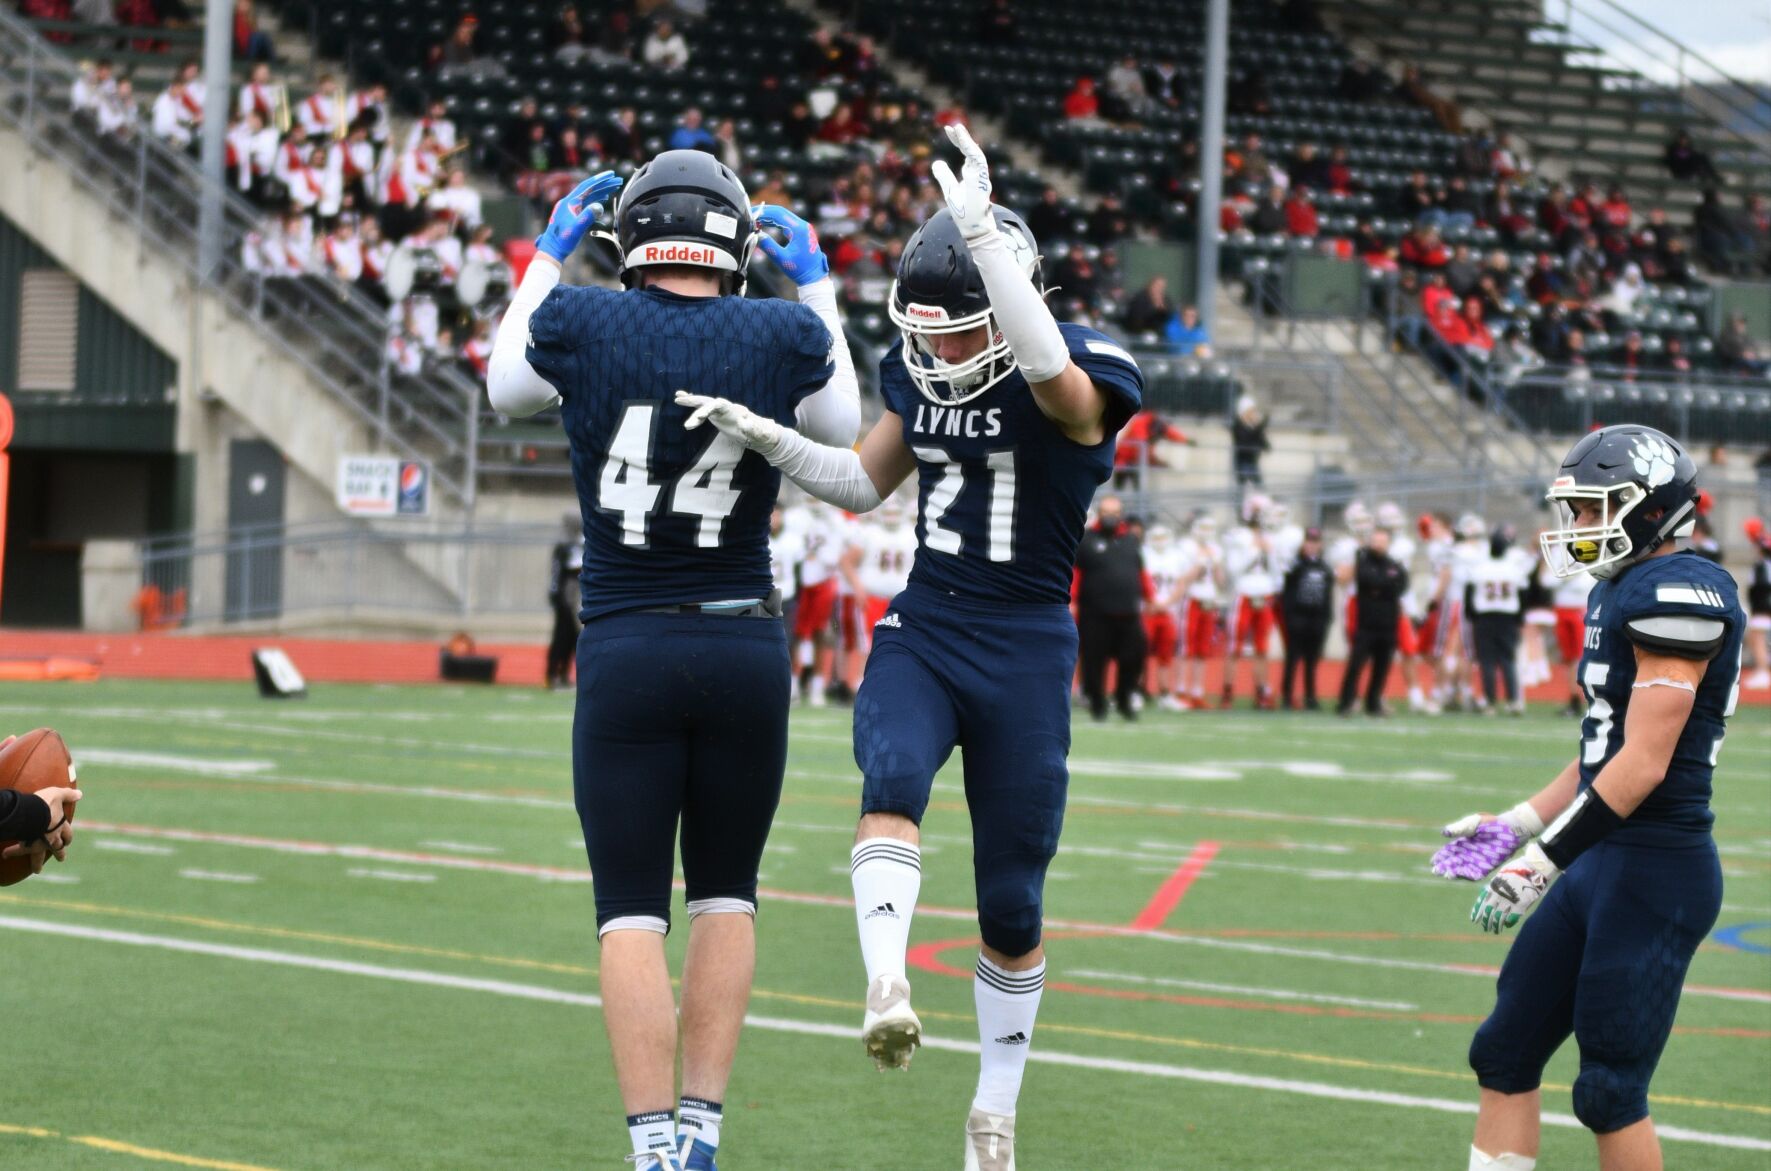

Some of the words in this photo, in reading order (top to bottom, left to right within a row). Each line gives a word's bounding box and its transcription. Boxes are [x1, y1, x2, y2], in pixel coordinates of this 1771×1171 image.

[645, 246, 715, 264] Riddell
[909, 307, 941, 318] Riddell
[913, 404, 1002, 438] LYNCS
[599, 406, 743, 548] 44
[912, 446, 1016, 562] 21
[1583, 626, 1602, 650] NCS
[637, 1114, 669, 1124] LYNCS
